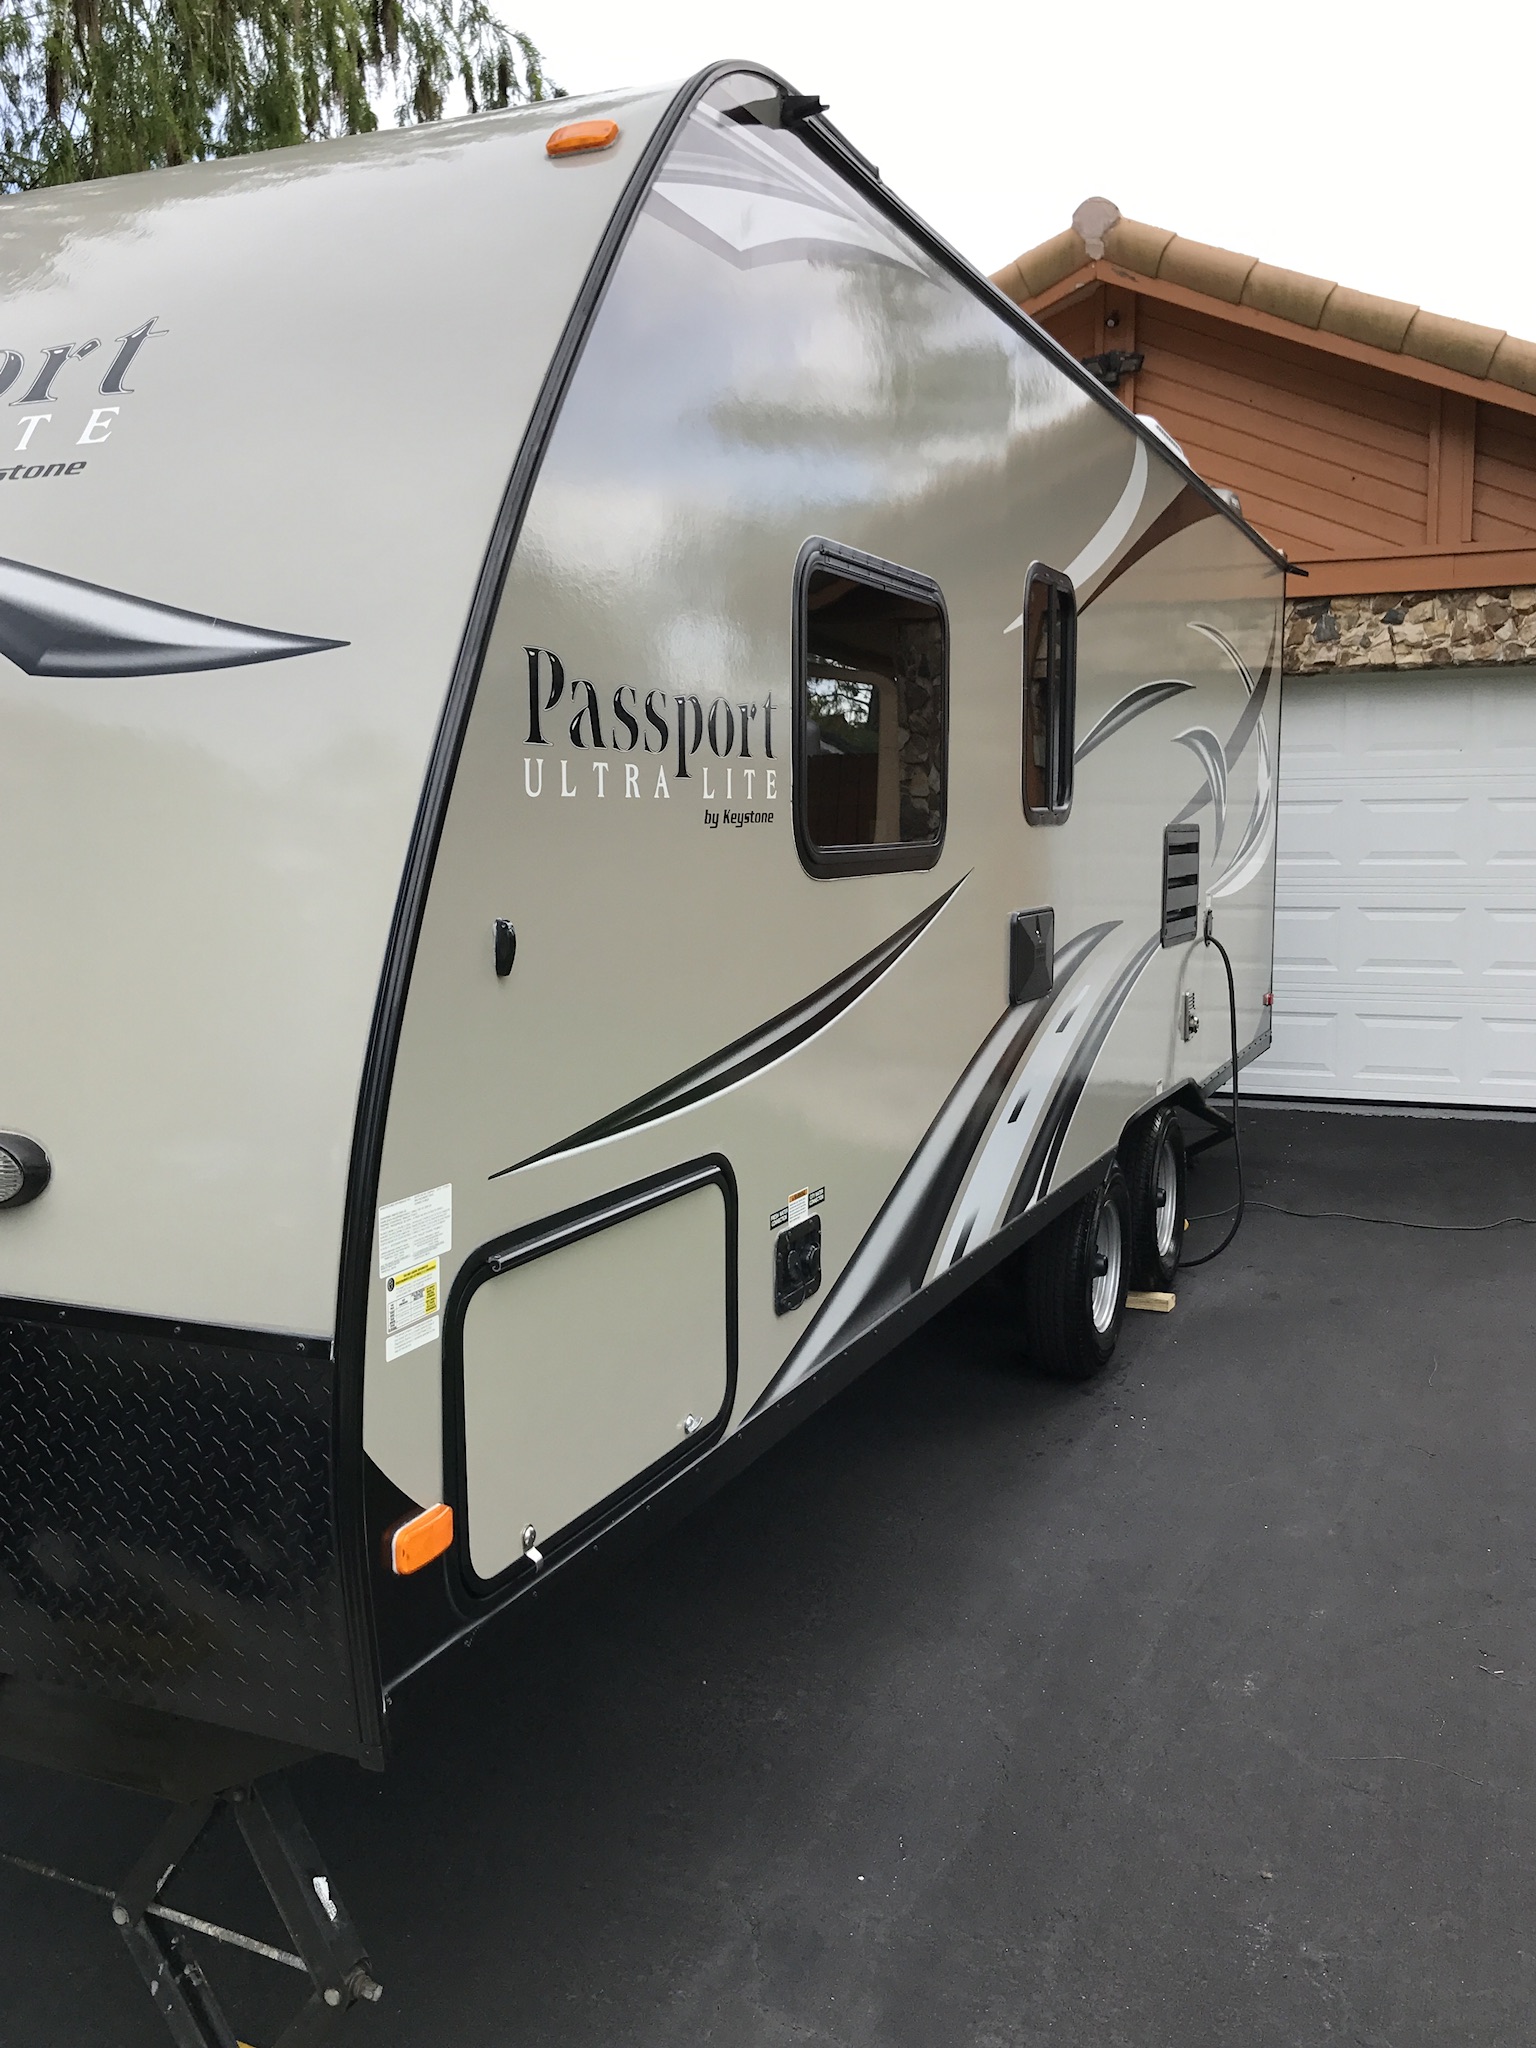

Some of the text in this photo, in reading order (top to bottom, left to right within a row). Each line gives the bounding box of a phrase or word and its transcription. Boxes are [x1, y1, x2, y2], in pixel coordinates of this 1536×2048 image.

[14, 406, 120, 452] TE
[521, 645, 778, 779] Passport
[523, 757, 778, 799] ULTRA LITE
[704, 809, 774, 828] by Keystone
